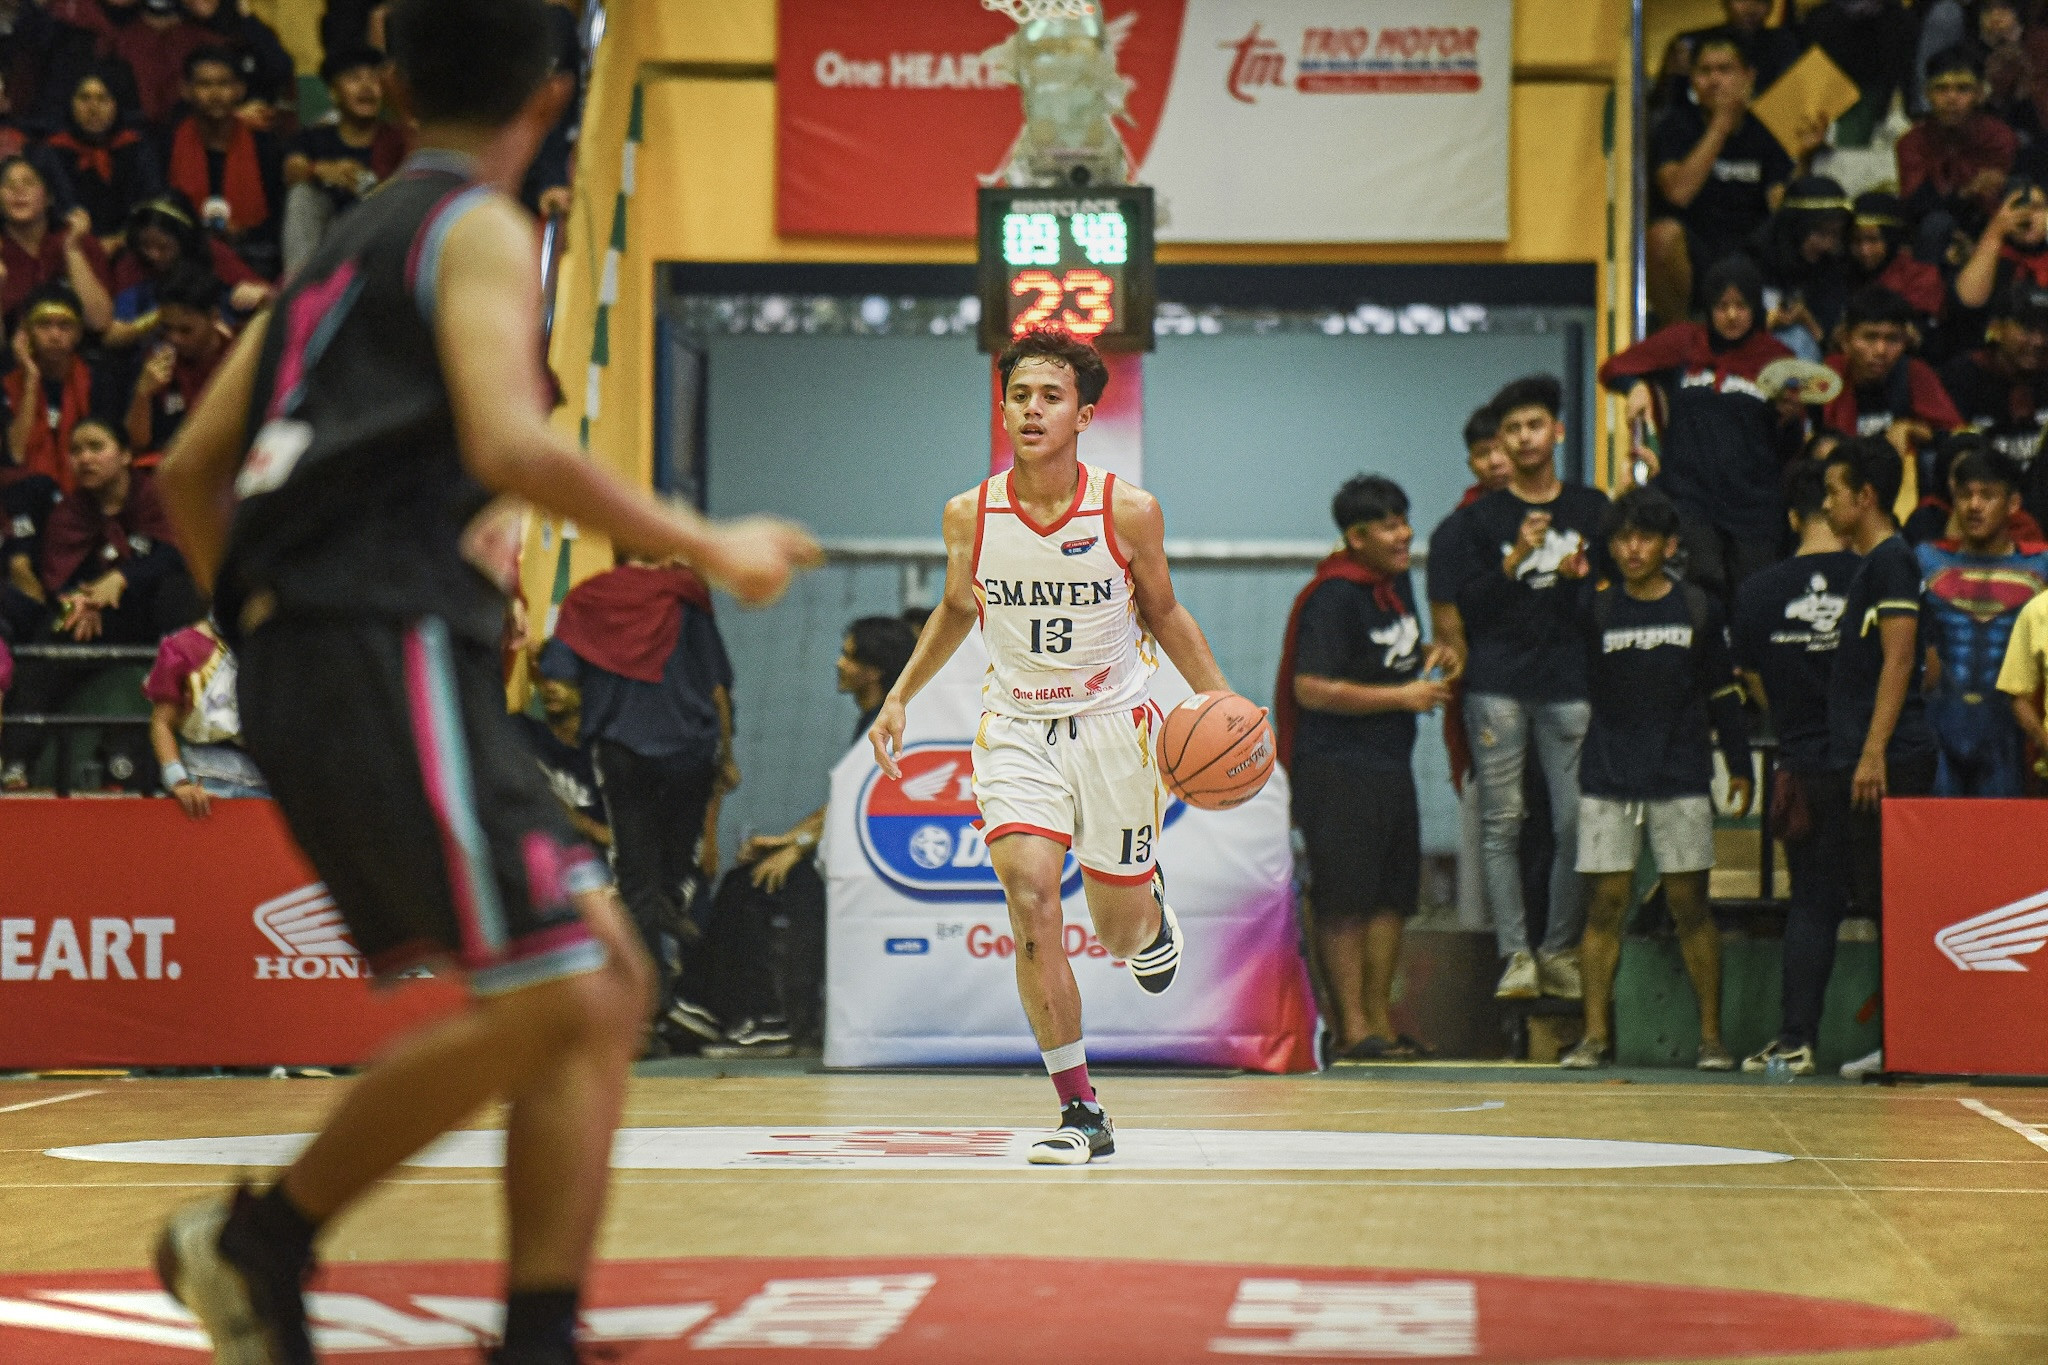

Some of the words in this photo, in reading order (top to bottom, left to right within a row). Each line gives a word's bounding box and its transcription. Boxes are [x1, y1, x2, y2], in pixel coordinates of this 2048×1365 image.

[815, 52, 883, 88] One
[1011, 270, 1114, 336] 23
[985, 578, 1112, 606] SMAVEN
[1030, 618, 1073, 654] 13
[1013, 687, 1033, 700] One
[1035, 687, 1074, 700] HEART.
[1118, 824, 1152, 864] 13
[0, 917, 182, 980] EART.
[1064, 924, 1126, 967] Da
